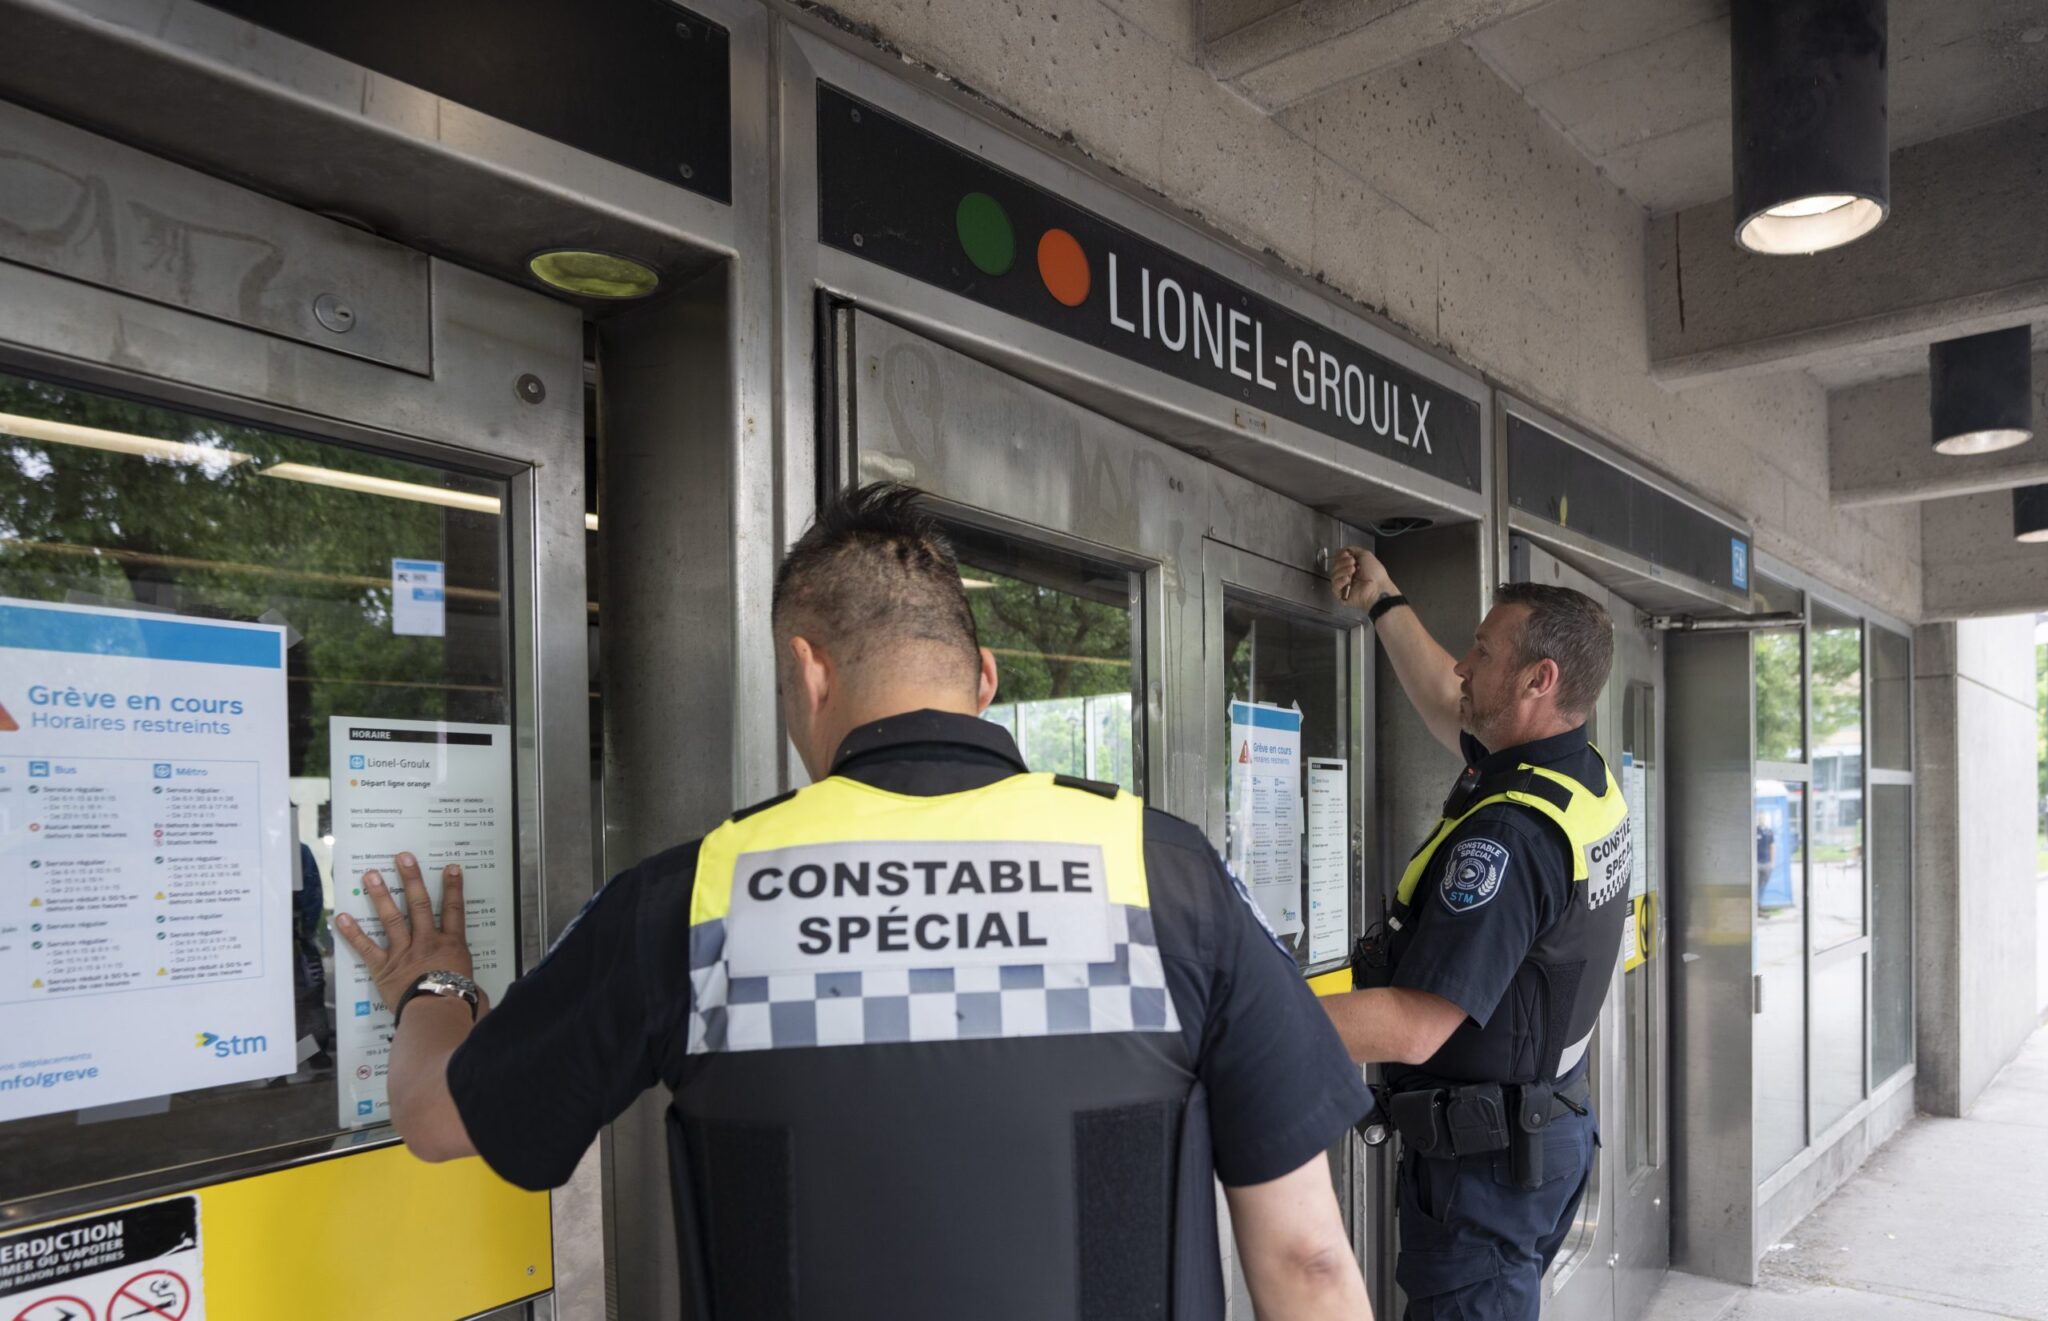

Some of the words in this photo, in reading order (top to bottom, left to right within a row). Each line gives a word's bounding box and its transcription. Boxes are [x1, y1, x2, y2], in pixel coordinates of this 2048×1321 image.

[1108, 252, 1432, 455] LIONEL-GROULX
[28, 685, 116, 709] Grève
[126, 695, 161, 711] en
[170, 697, 244, 715] cours
[31, 711, 125, 731] Horaires
[133, 717, 231, 735] restreints
[352, 730, 393, 740] HORAIRE
[1269, 745, 1277, 753] en
[1278, 746, 1292, 755] cours
[54, 765, 78, 775] Bus
[367, 758, 430, 769] Lionel-Groulx
[175, 767, 208, 777] Métro
[361, 779, 386, 788] Départ
[387, 780, 405, 789] ligne
[406, 781, 431, 789] orange
[1457, 841, 1502, 857] CONSTABLE
[1460, 849, 1492, 862] SPÉCIAL
[747, 860, 1093, 901] CONSTABLE
[1450, 891, 1474, 904] STM
[797, 907, 1048, 956] SPÉCIAL
[215, 1034, 267, 1058] stm
[36, 1253, 59, 1269] OU
[61, 1238, 124, 1262] VAPOTER
